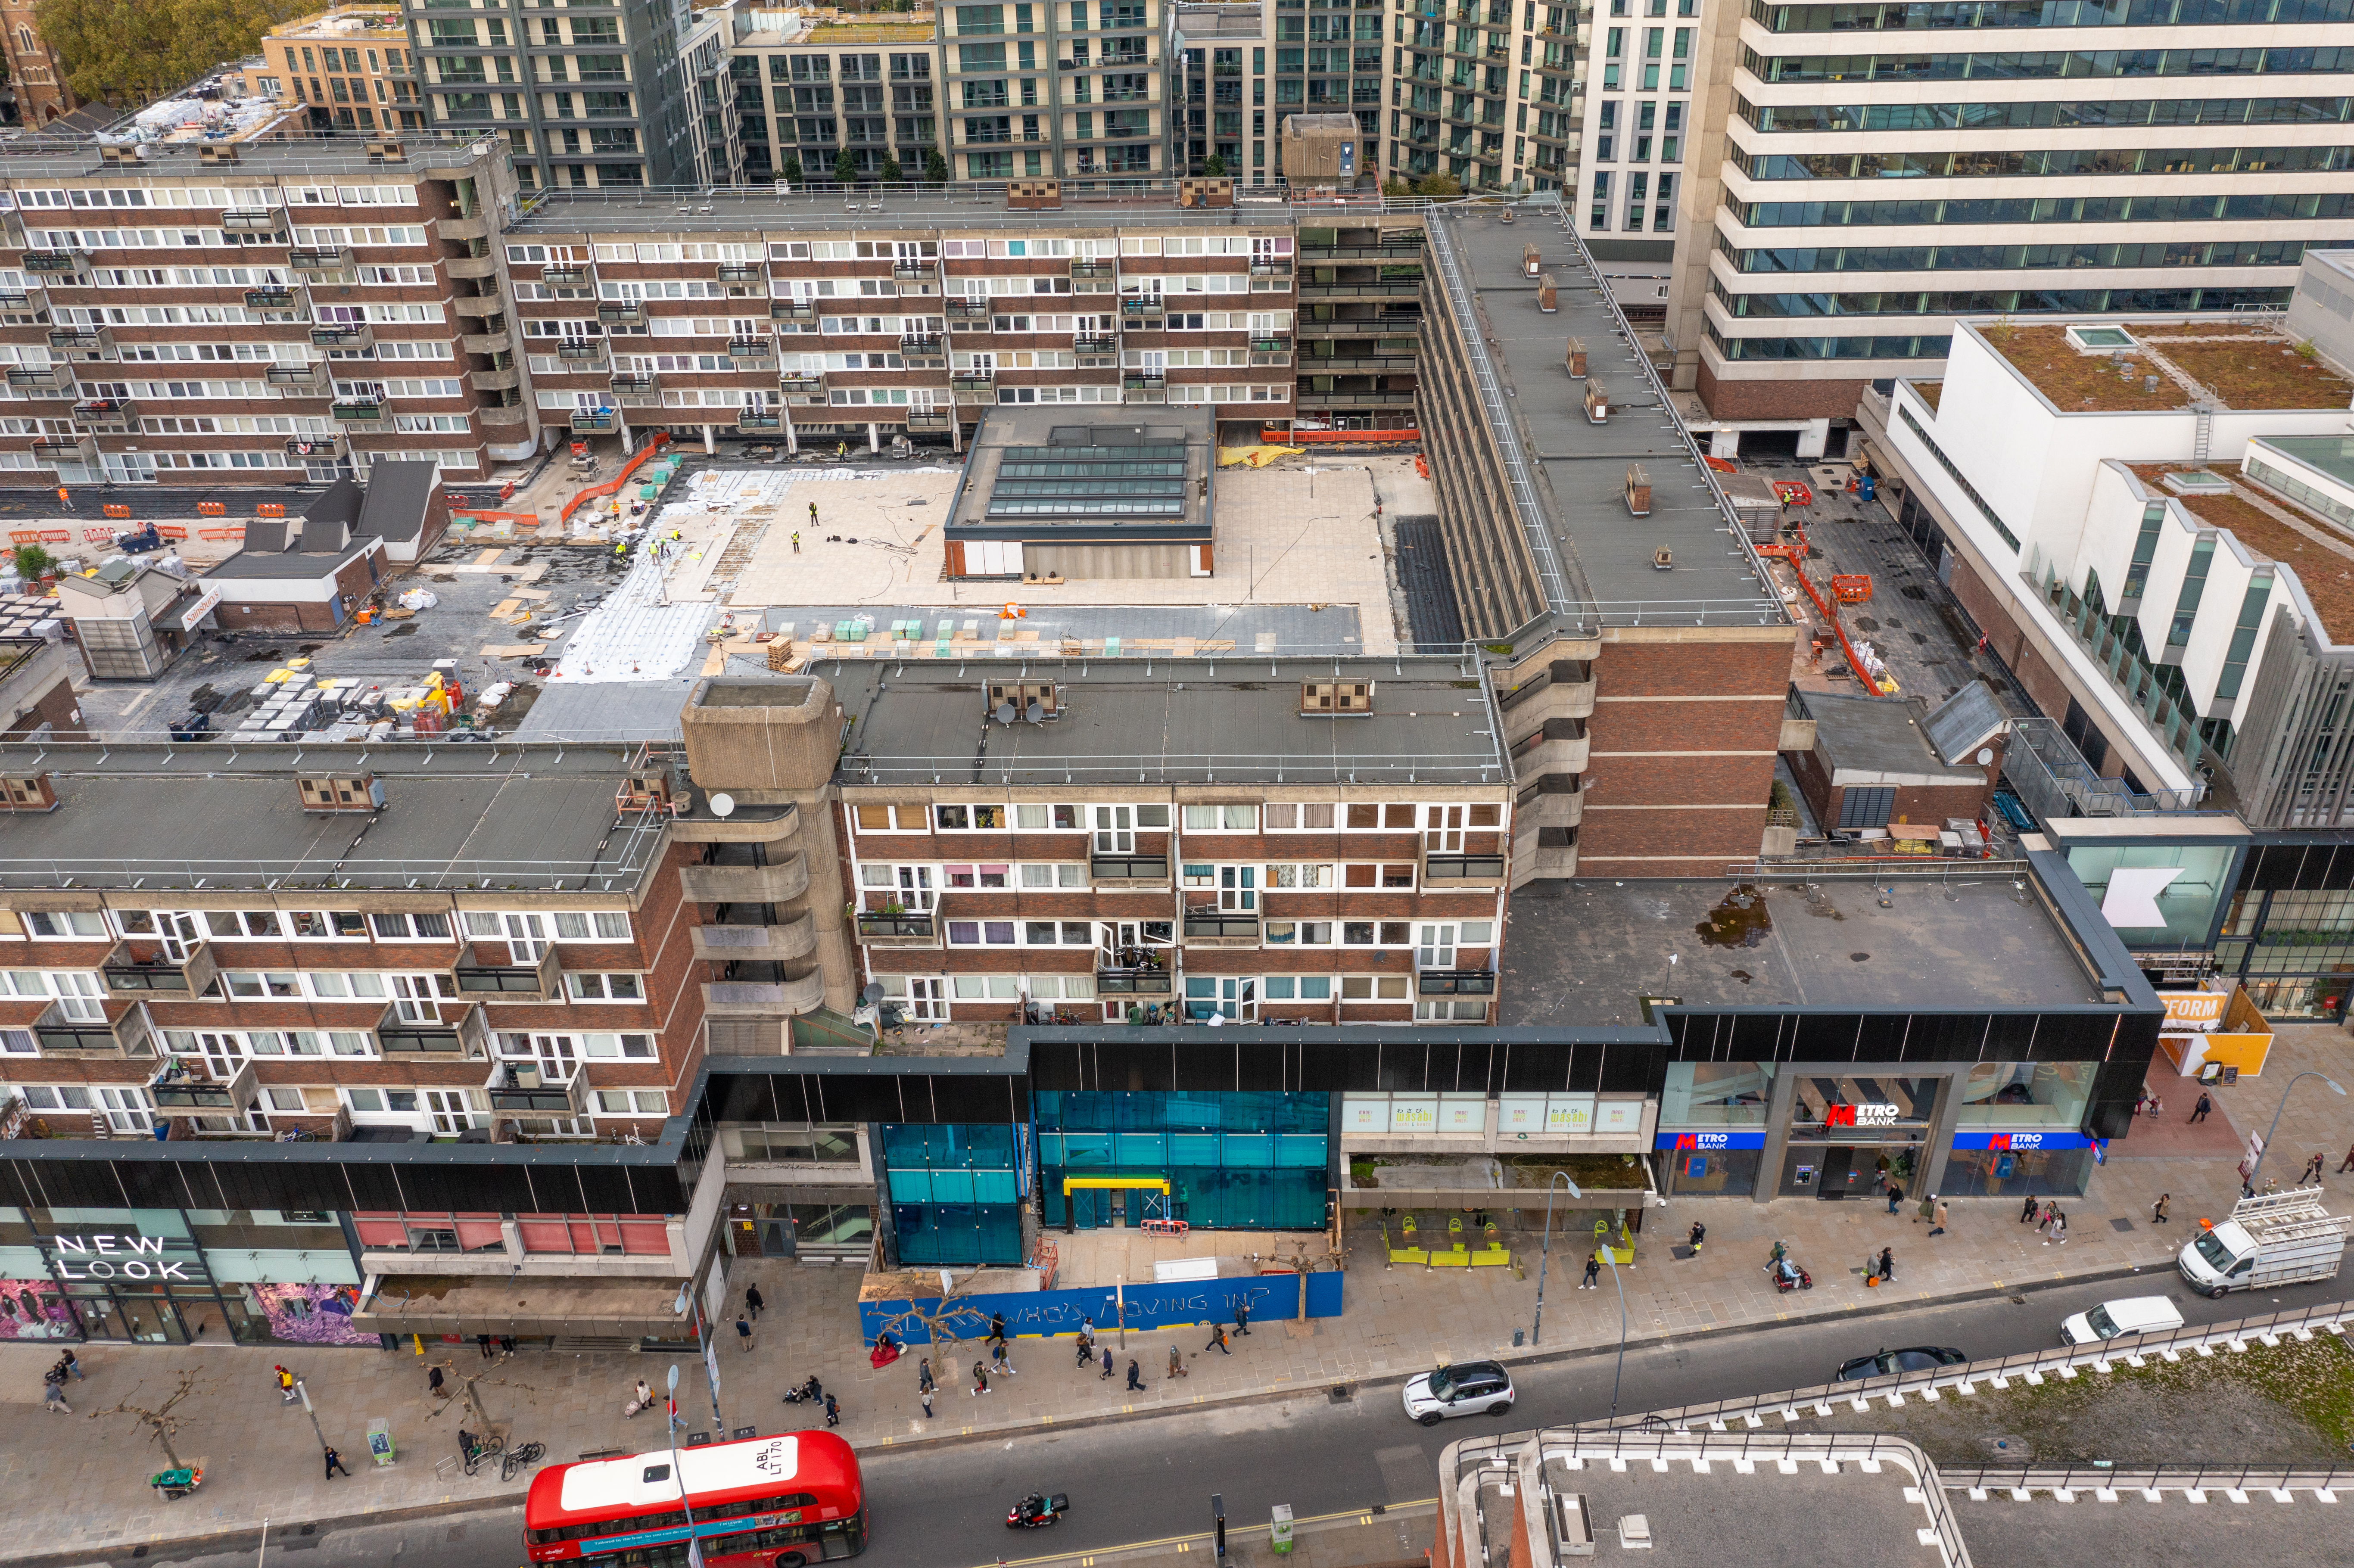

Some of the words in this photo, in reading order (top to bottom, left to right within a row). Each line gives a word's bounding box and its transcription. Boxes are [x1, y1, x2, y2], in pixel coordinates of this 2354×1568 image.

[187, 590, 219, 625] Sainsbury's
[1396, 1110, 1432, 1122] wasabi
[1551, 1110, 1588, 1122] wasabi
[1825, 1104, 1899, 1126] METRO
[1856, 1117, 1897, 1126] BANK
[1675, 1133, 1728, 1149] METRO
[1988, 1134, 2043, 1150] METRO
[55, 1235, 164, 1255] NEW
[57, 1260, 190, 1280] LOOK
[1100, 1294, 1208, 1318] MOVING
[756, 1448, 768, 1470] ABL
[770, 1462, 782, 1475] LT
